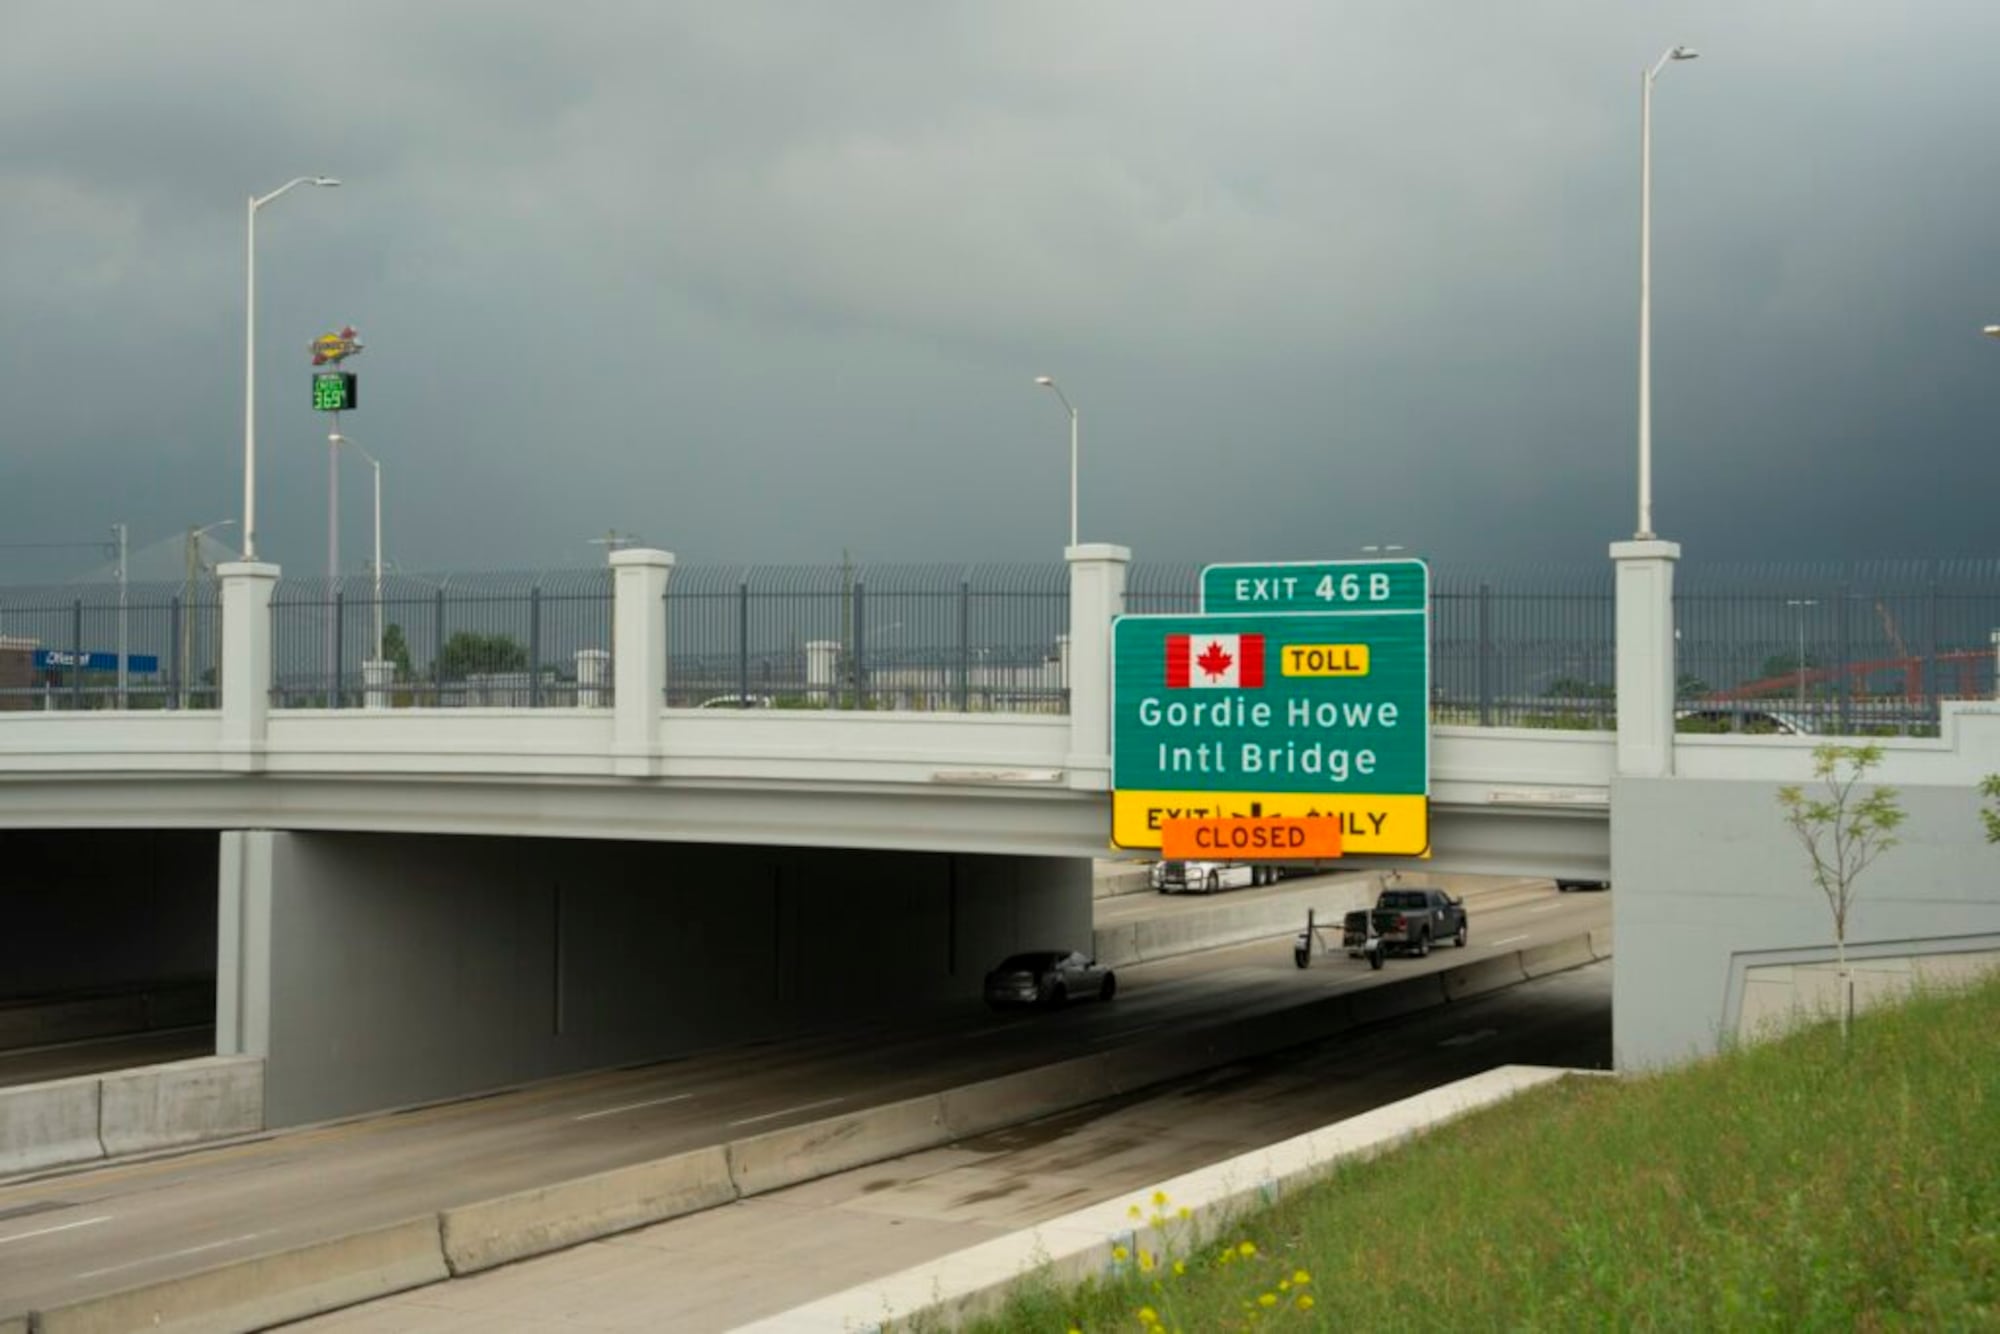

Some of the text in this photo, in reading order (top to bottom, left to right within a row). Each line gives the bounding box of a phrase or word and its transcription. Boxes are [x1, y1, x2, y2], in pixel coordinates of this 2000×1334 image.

[1235, 577, 1298, 601] EXIT
[1291, 650, 1360, 671] TOLL
[1139, 696, 1399, 728] Gordie Howe
[1158, 741, 1377, 782] Intl Bridge
[1195, 826, 1305, 848] CLOSED
